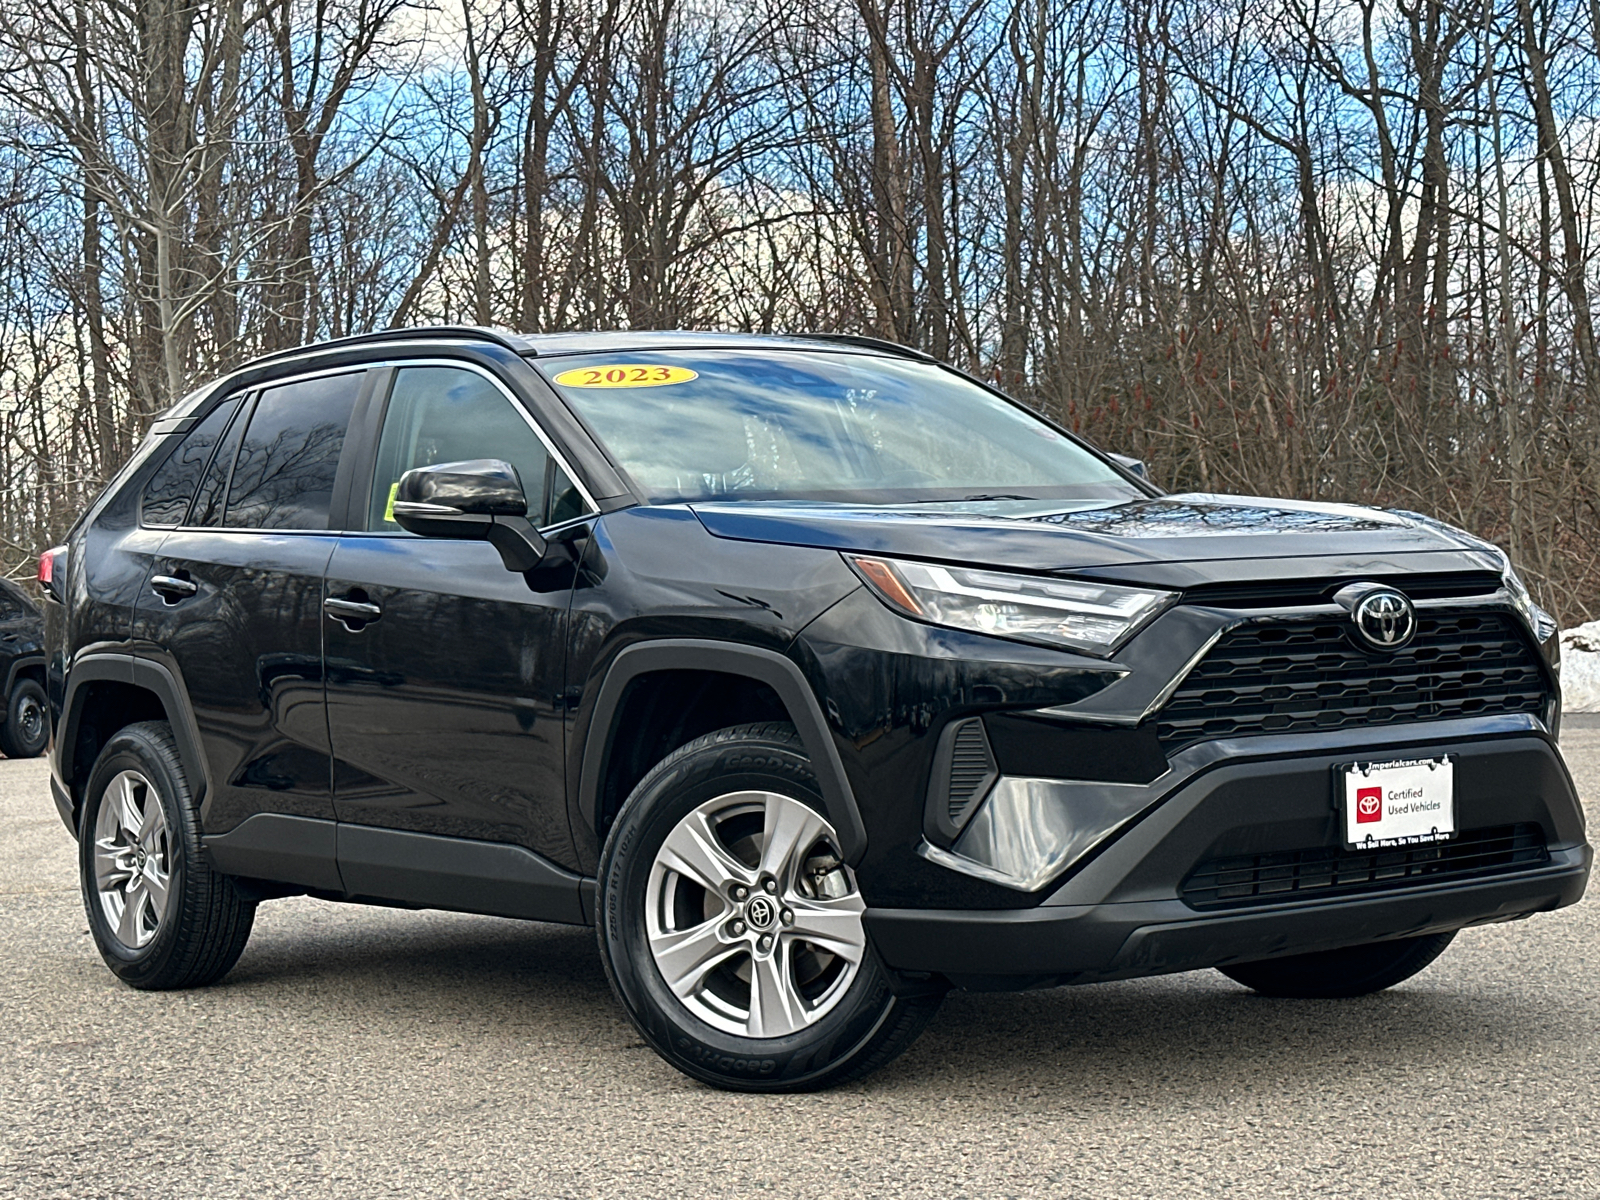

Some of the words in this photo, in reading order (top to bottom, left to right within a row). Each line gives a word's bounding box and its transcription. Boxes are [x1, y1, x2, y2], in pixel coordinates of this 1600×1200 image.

[583, 367, 671, 385] 2023
[724, 752, 818, 780] GeoDriv
[1368, 759, 1434, 771] Imperialcars.com
[1388, 787, 1423, 800] Certified
[1388, 803, 1408, 815] Used
[1410, 800, 1441, 812] Vehicles
[618, 824, 637, 857] 102H
[1356, 842, 1367, 850] We
[1367, 840, 1379, 849] Sell
[1380, 839, 1397, 847] More,
[1398, 837, 1407, 845] So
[1407, 836, 1419, 844] You
[1420, 835, 1434, 843] Save
[611, 862, 622, 890] R17
[609, 894, 619, 941] 225/65
